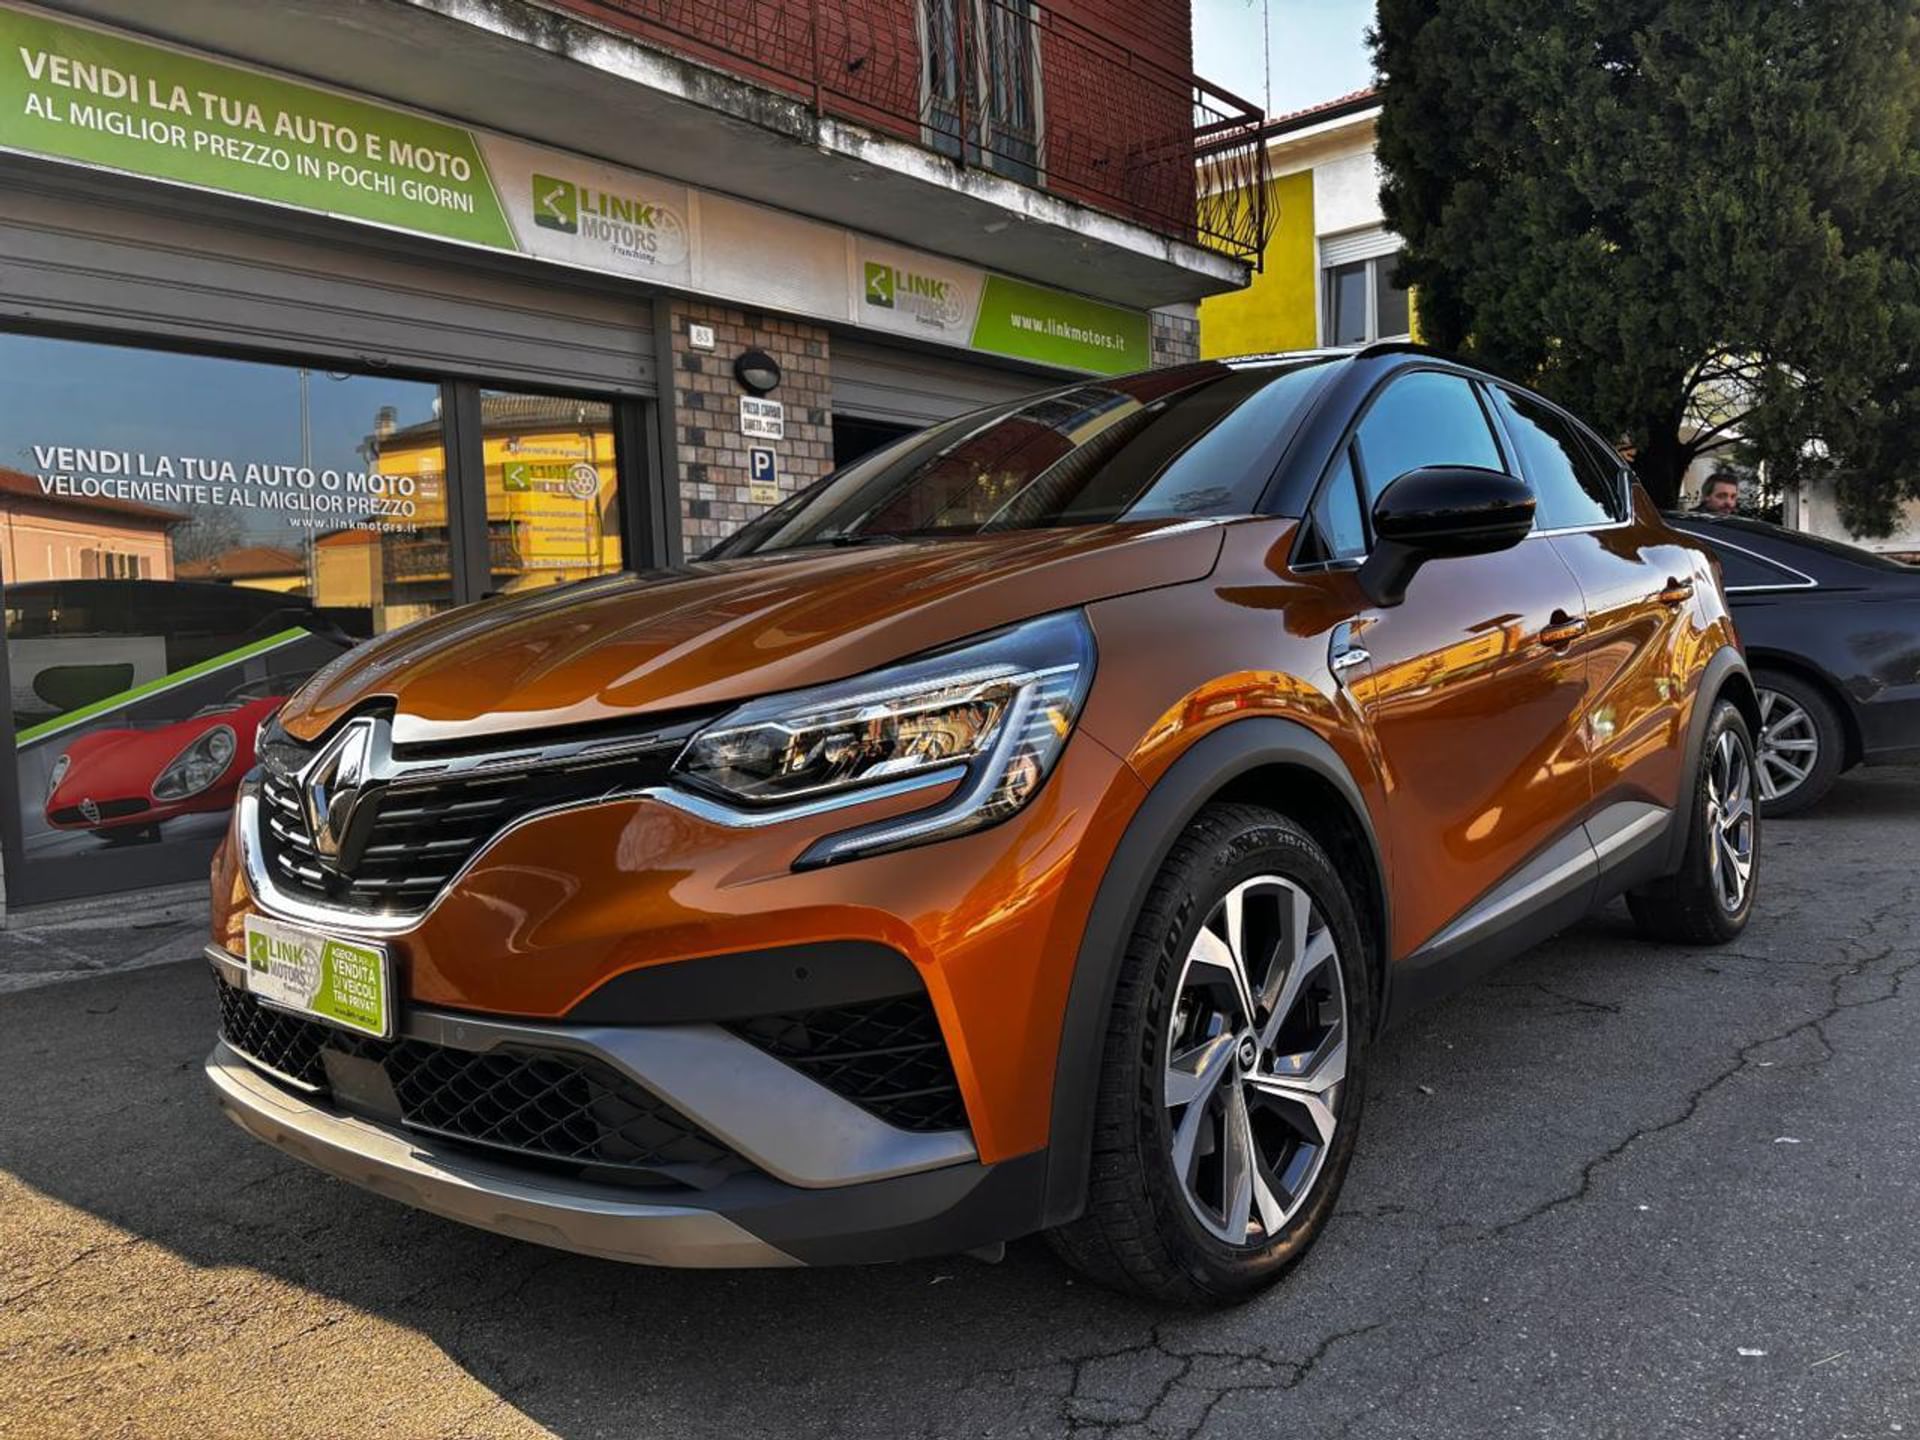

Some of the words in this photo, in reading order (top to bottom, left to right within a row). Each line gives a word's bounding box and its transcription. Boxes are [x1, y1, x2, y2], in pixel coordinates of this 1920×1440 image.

[19, 47, 139, 103] VENDI
[148, 79, 192, 116] LA
[197, 91, 266, 134] TUA
[274, 111, 359, 154] AUTO
[365, 133, 382, 161] E
[389, 139, 471, 182] MOTO
[24, 92, 62, 122] AL
[69, 102, 187, 149] MIGLIOR
[194, 130, 290, 171] PREZZO
[296, 153, 321, 179] IN
[327, 161, 396, 196] POCHI
[401, 179, 474, 214] GIORNI
[580, 188, 655, 229] LINK
[582, 216, 658, 253] MOTORS
[895, 269, 944, 301] LINK
[1010, 312, 1126, 352] www.linkmotors.it
[33, 445, 130, 474] VENDI
[138, 453, 175, 478] LA
[179, 457, 237, 483] TUA
[244, 463, 316, 489] AUTO
[321, 470, 340, 490] O
[346, 471, 416, 496] MOTO
[754, 452, 770, 478] P
[37, 475, 208, 504] VELOCEMENTE
[212, 486, 224, 505] E
[229, 487, 257, 508] AL
[259, 491, 343, 513] MIGLIOR
[346, 497, 416, 518] PREZZO
[288, 517, 417, 534] www.linkmotors.it
[268, 937, 304, 966] LINK
[270, 960, 306, 986] MOTORS
[331, 957, 377, 985] VENDITA
